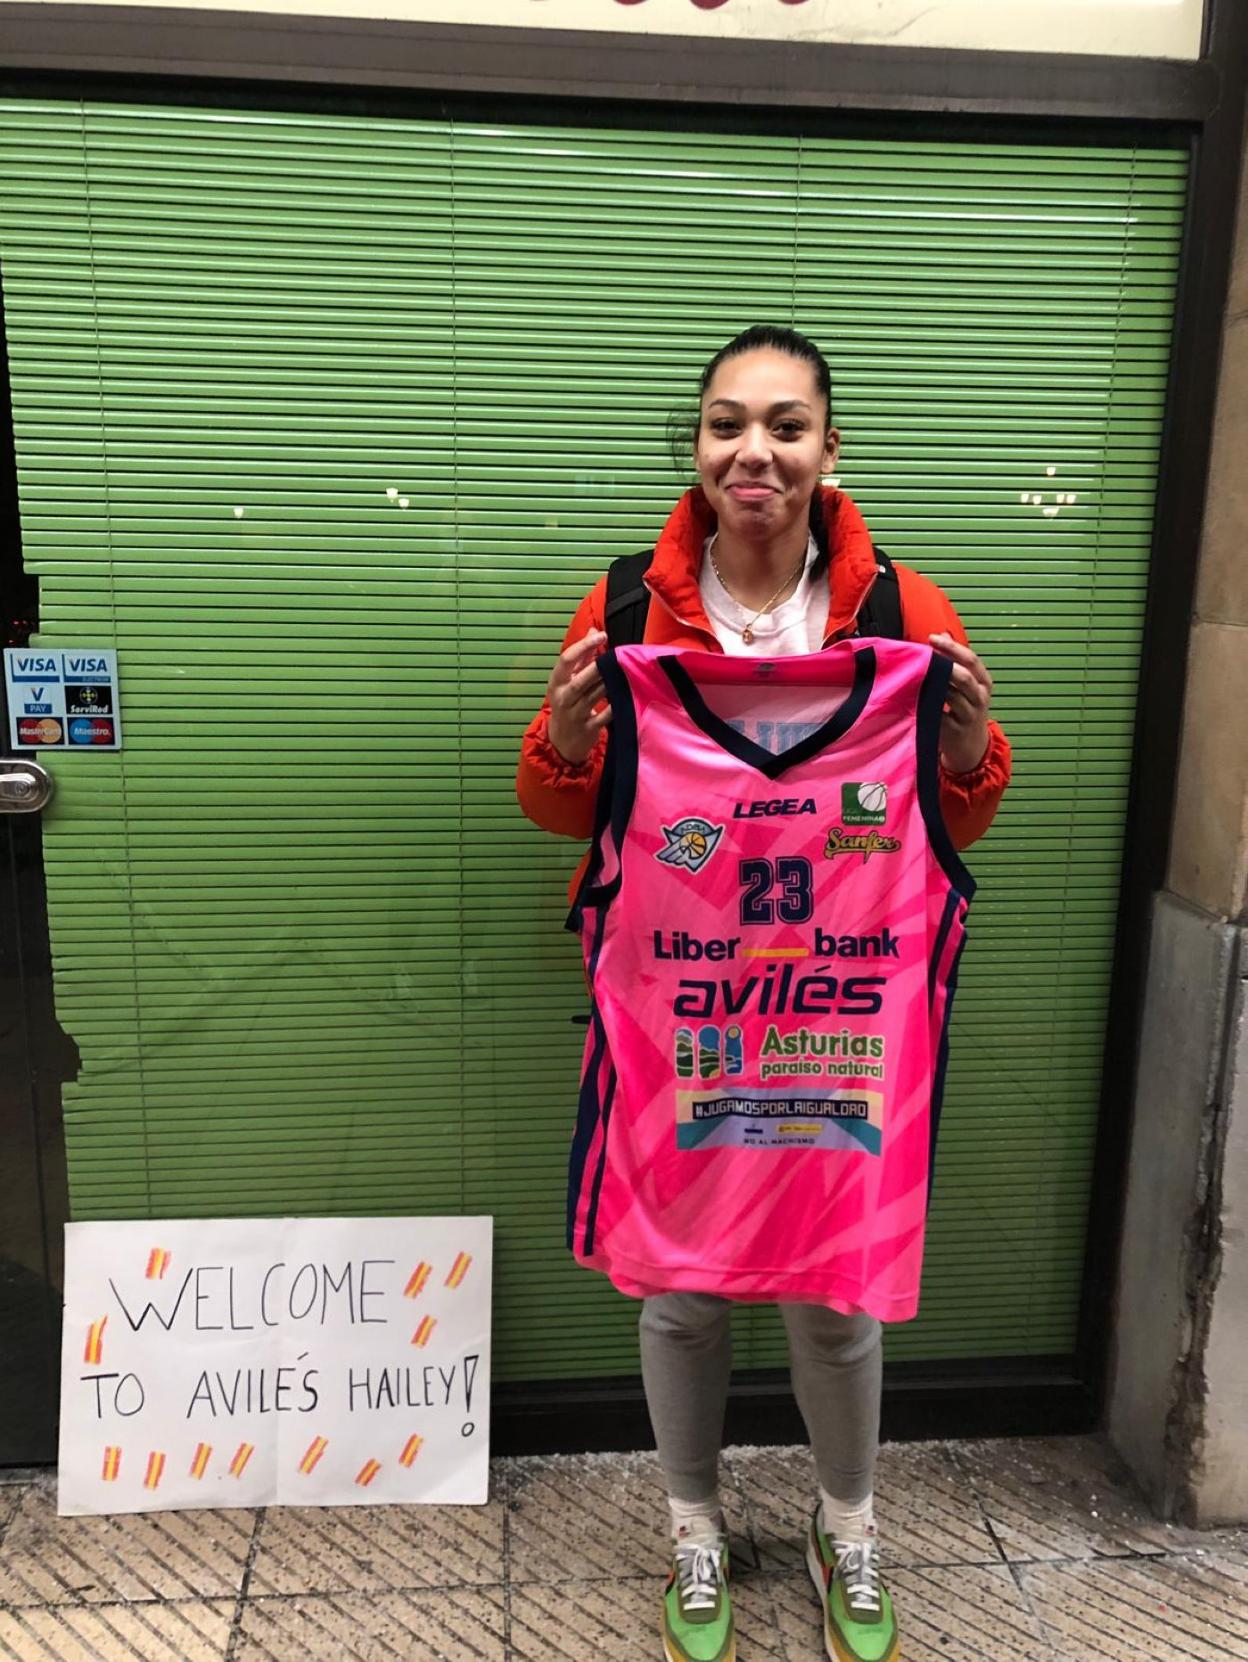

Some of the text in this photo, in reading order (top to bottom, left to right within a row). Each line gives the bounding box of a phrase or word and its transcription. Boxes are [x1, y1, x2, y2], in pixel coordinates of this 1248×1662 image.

[17, 658, 56, 672] VISA
[69, 658, 107, 672] VISA
[31, 687, 44, 701] V
[30, 704, 46, 712] PAY
[70, 704, 109, 714] ServiRed
[733, 798, 817, 819] LEGEA
[739, 856, 814, 926] 23
[653, 927, 900, 961] Liber bank
[673, 964, 887, 1018] avilés
[761, 1025, 884, 1058] Asturias
[828, 1059, 884, 1079] natural
[109, 1260, 395, 1331] WELCOME
[80, 1352, 480, 1437] TO AVILÉS HAILEY!
